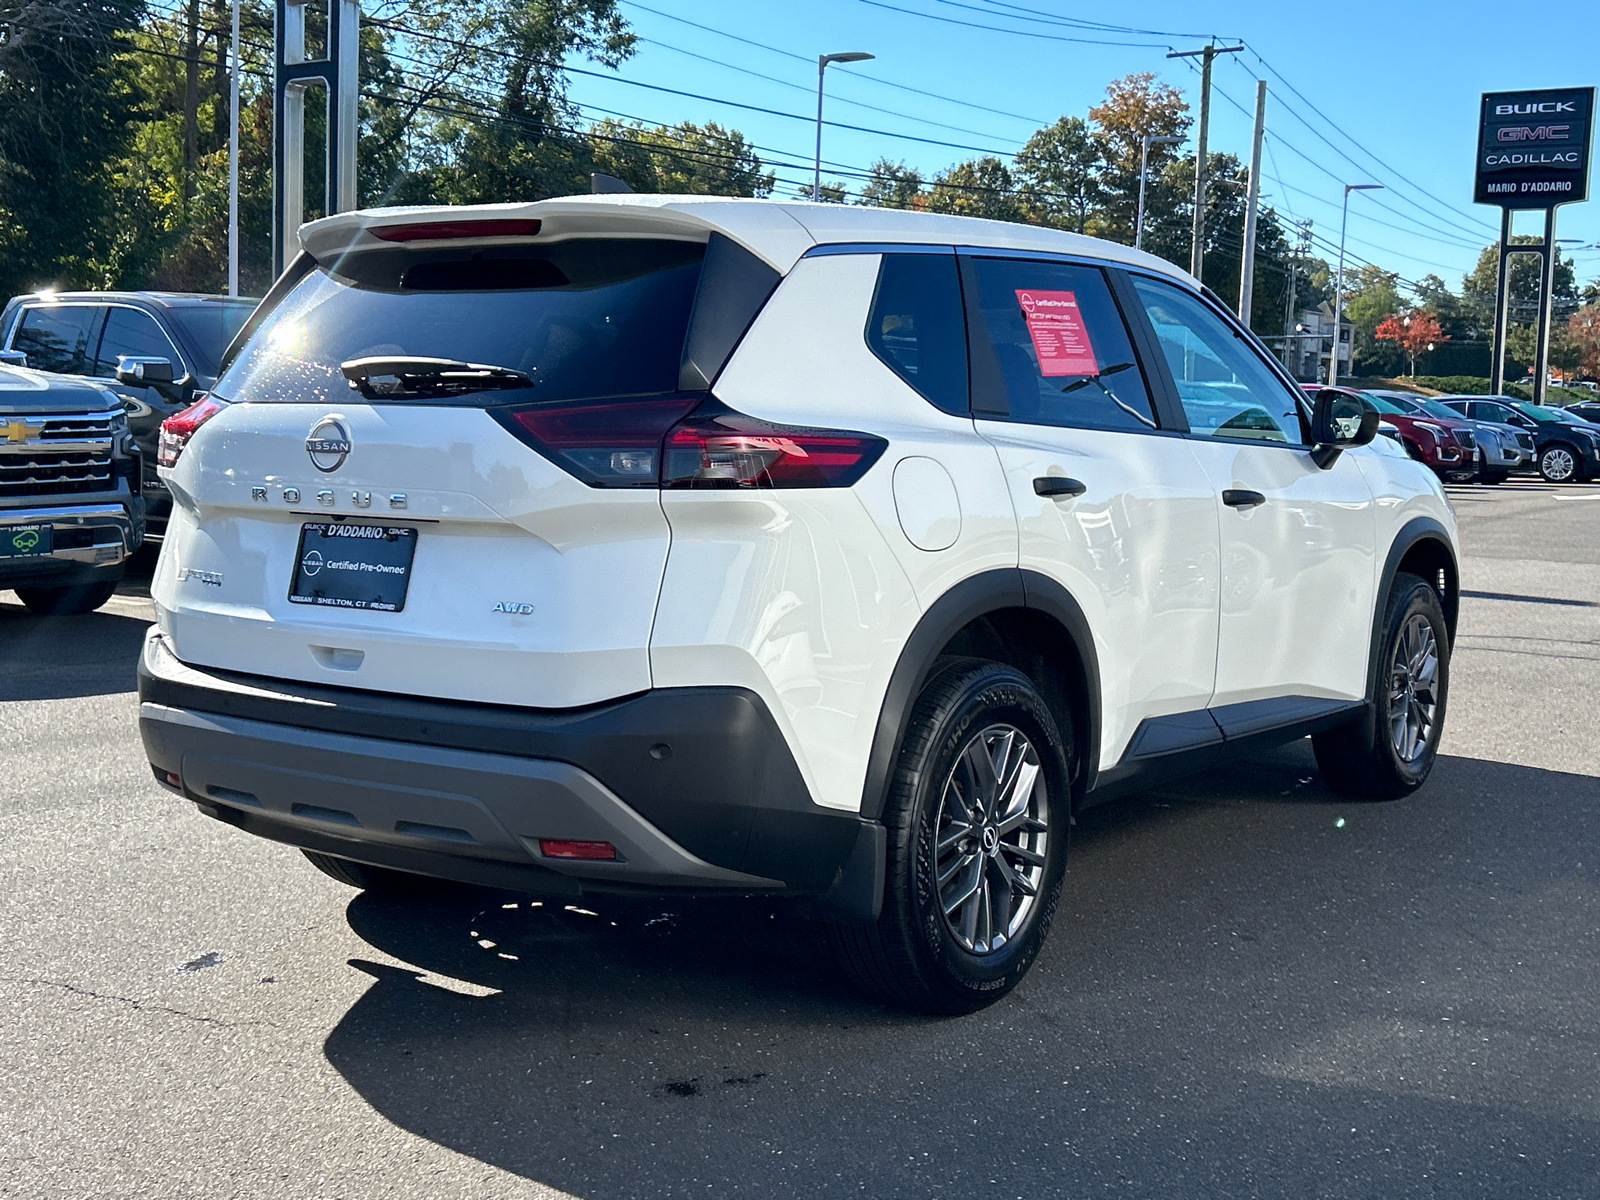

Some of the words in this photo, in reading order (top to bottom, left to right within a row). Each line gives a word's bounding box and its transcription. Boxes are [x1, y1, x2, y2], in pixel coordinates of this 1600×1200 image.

[1495, 101, 1576, 115] BUICK
[1497, 125, 1570, 142] GMC
[1485, 152, 1578, 165] CADILLAC
[1487, 183, 1517, 193] MARIO
[1521, 181, 1572, 193] D'ADDARIO
[306, 441, 350, 451] NISSAN
[251, 485, 408, 510] ROGUE
[304, 523, 326, 531] BUICK
[327, 524, 383, 539] D'ADDARIO
[388, 528, 410, 536] GMC
[326, 560, 358, 571] Certified
[359, 563, 406, 575] Pre-Owned
[290, 595, 313, 603] NISSAN
[317, 598, 354, 607] SHELTON,
[491, 601, 535, 615] AWD
